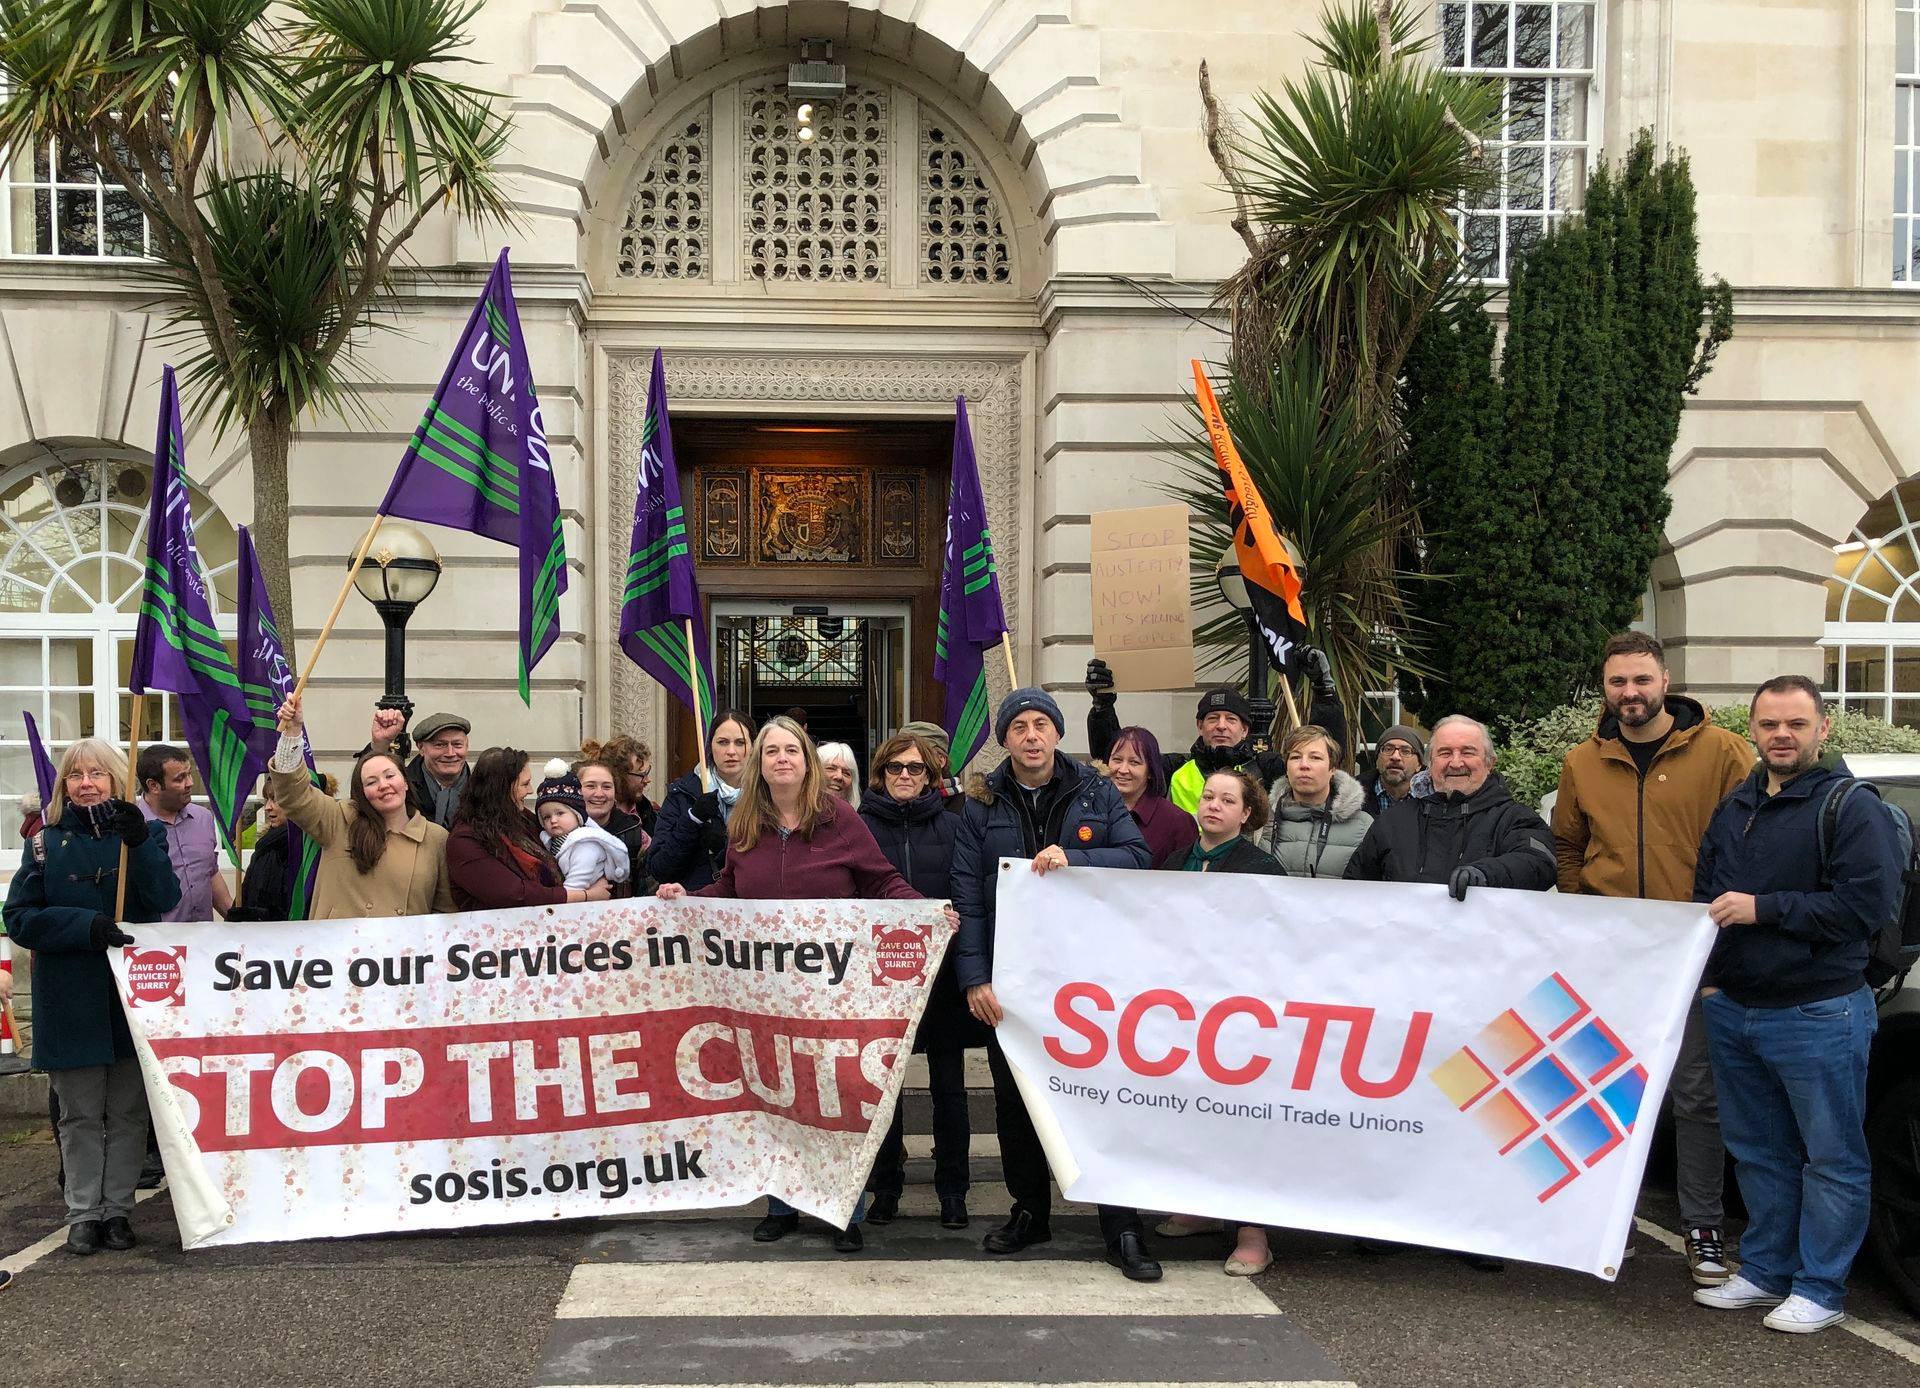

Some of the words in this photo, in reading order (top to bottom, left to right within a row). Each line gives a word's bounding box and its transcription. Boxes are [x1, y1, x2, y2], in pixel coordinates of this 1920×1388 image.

[456, 376, 480, 396] the
[1107, 529, 1175, 551] STOP
[213, 951, 332, 992] Save
[348, 954, 434, 988] our
[447, 935, 632, 982] Services
[647, 927, 693, 967] in
[704, 928, 854, 986] Surrey
[876, 951, 914, 959] SERVICES
[128, 972, 167, 981] SERVICES
[155, 963, 175, 971] OUR
[136, 981, 170, 990] SURREY
[1042, 981, 1433, 1099] SCCTU
[159, 1047, 425, 1137] STOP
[446, 1031, 650, 1124] THE
[675, 1021, 906, 1120] CUTS
[1048, 1075, 1109, 1105] Surrey
[1116, 1086, 1188, 1114] County
[1195, 1096, 1272, 1121] Council
[1280, 1104, 1341, 1128] Trade
[1349, 1111, 1425, 1135] Unions
[410, 1140, 707, 1205] sosis.org.uk
